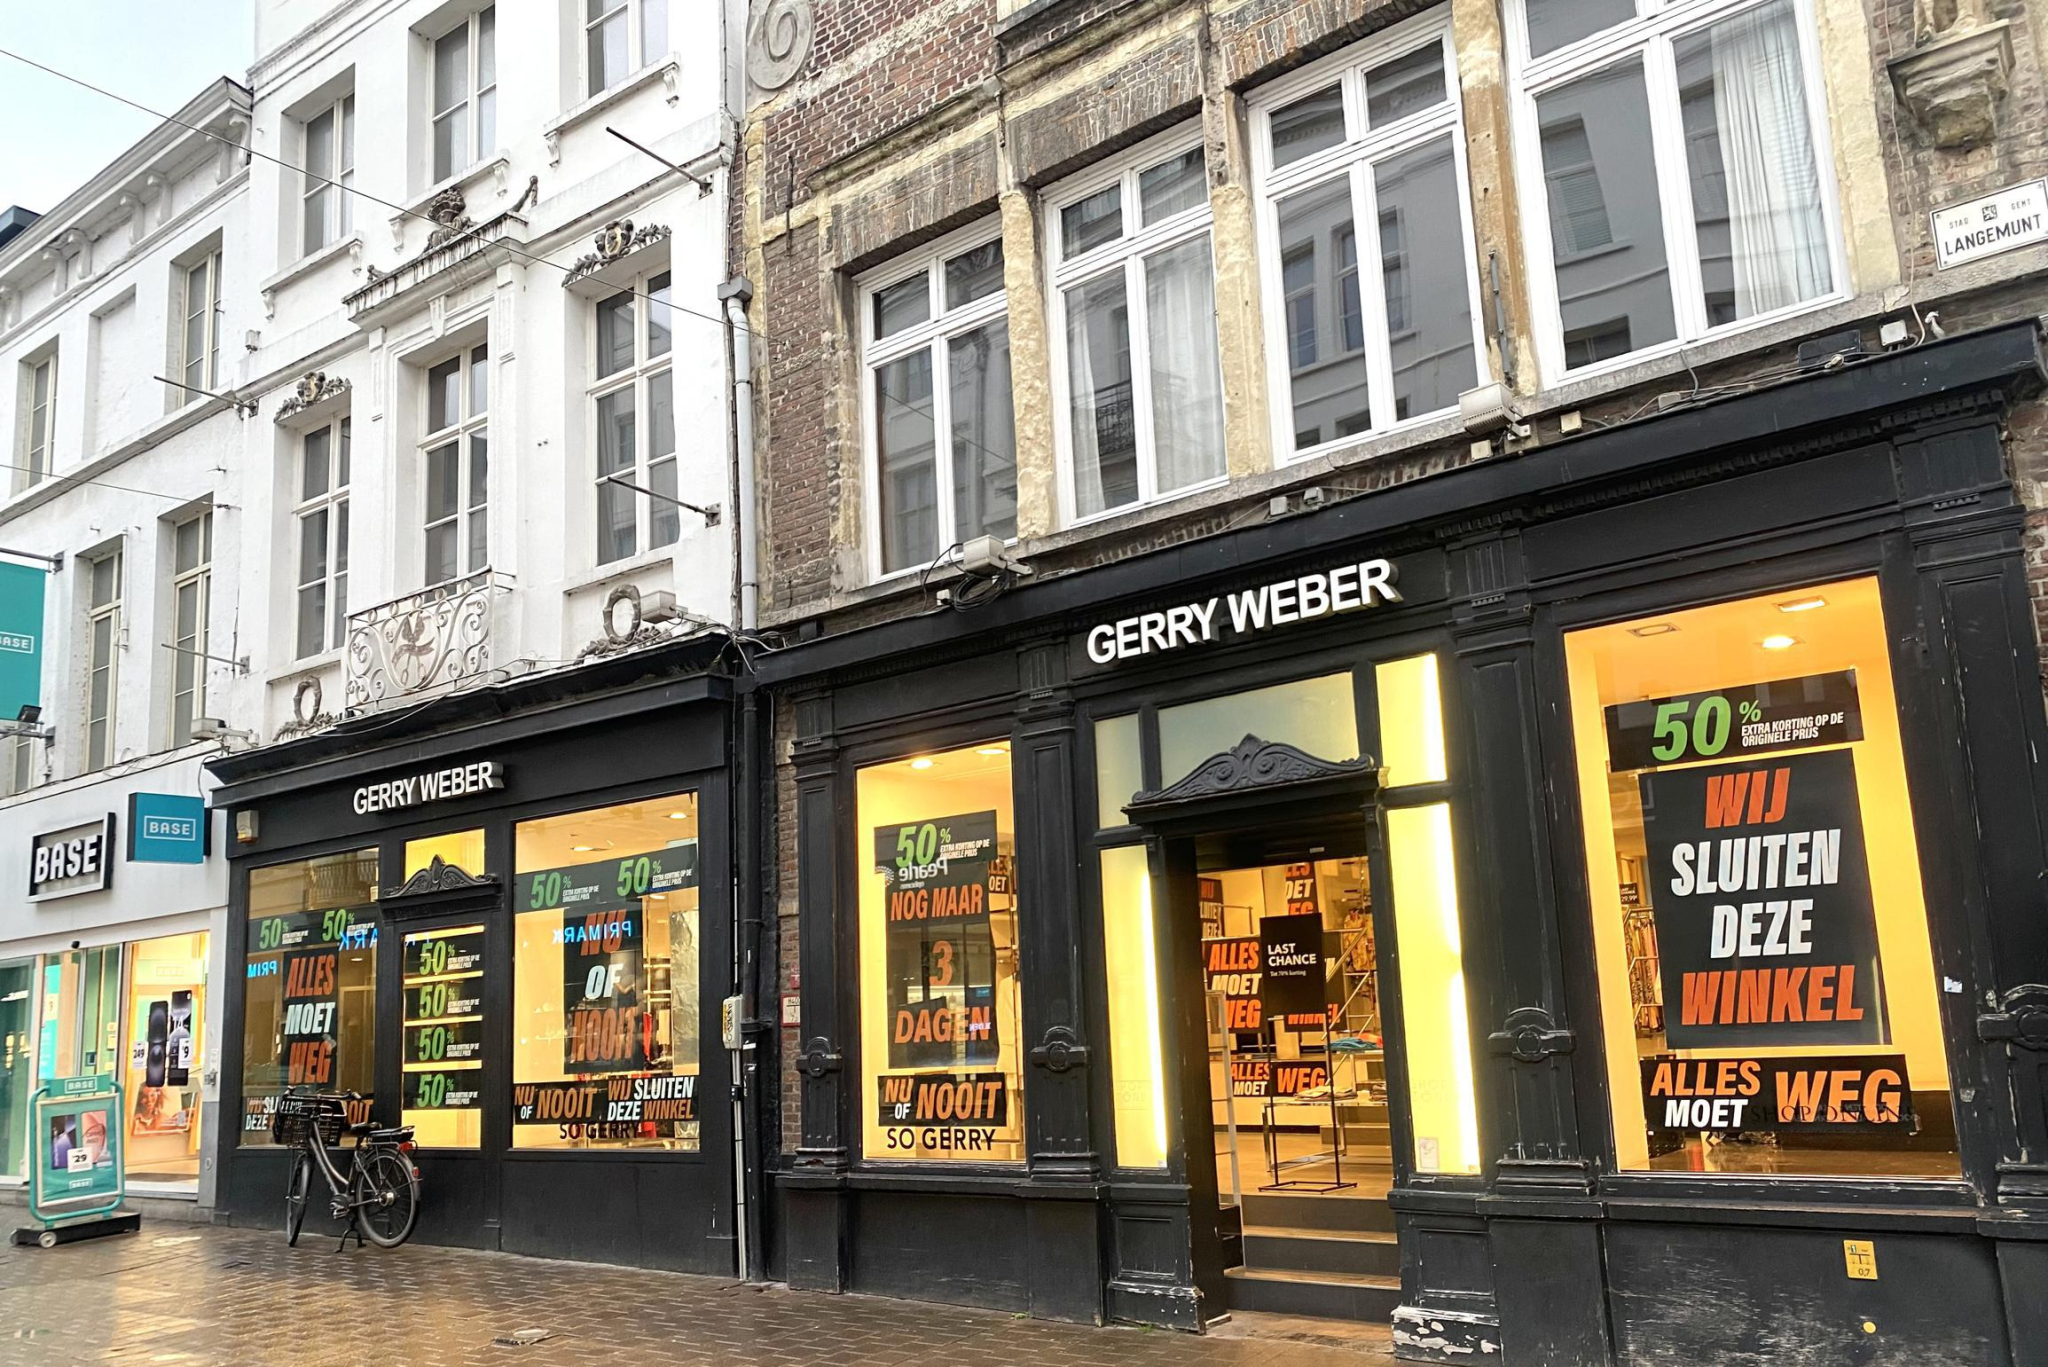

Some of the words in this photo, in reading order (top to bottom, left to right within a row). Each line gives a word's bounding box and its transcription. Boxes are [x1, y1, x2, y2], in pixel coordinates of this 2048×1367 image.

[1944, 213, 2041, 256] LANGEMUNT
[1949, 217, 1969, 229] STAD
[1087, 598, 1219, 664] GERRY
[1226, 558, 1397, 634] WEBER
[1741, 723, 1770, 737] EXTRA
[1772, 717, 1814, 731] KORTING
[1815, 714, 1830, 726] OP
[1830, 712, 1845, 725] DE
[1742, 731, 1791, 748] ORIGINELE
[1792, 727, 1819, 741] PRIJS
[353, 777, 417, 815] GERRY
[420, 761, 494, 802] WEBER
[1704, 767, 1791, 829] WIJ
[149, 821, 191, 835] BASE
[34, 835, 99, 883] BASE
[1671, 828, 1842, 897] SLUITEN
[989, 875, 1007, 892] OET
[1285, 878, 1314, 900] OET
[891, 888, 928, 921] NOG
[932, 883, 983, 917] MAAR
[580, 909, 627, 956] NU
[1710, 899, 1815, 959] DEZE
[929, 940, 953, 986] 3
[1208, 941, 1260, 971] ALLES
[1267, 943, 1296, 955] LAST
[1268, 953, 1317, 967] CHANCE
[285, 954, 335, 997] ALLES
[585, 963, 625, 1000] OF
[1211, 973, 1263, 996] MOET
[1681, 964, 1865, 1026] WINKEL
[284, 1002, 336, 1035] MOET
[894, 1006, 990, 1044] DAGEN
[570, 1006, 638, 1062] NOOIT
[288, 1041, 332, 1085] WEG
[1231, 1063, 1270, 1080] ALLES
[67, 1080, 94, 1090] BASE
[607, 1079, 632, 1100] WIJ
[633, 1076, 695, 1100] SLUITEN
[884, 1078, 914, 1102] NU
[1233, 1081, 1268, 1096] MOET
[1277, 1067, 1326, 1093] WEG
[1650, 1060, 1762, 1097] ALLES
[514, 1085, 535, 1106] NU
[536, 1088, 598, 1120] NOOIT
[606, 1101, 641, 1122] DEZE
[643, 1099, 694, 1120] WINKEL
[916, 1081, 1002, 1120] NOOIT
[1775, 1069, 1902, 1124] WEG
[245, 1114, 269, 1131] DEZE
[520, 1105, 533, 1120] OF
[895, 1103, 912, 1120] OF
[1664, 1098, 1749, 1128] MOET
[559, 1121, 581, 1140] SO
[585, 1120, 641, 1139] GERRY
[886, 1127, 916, 1150] SO
[922, 1127, 996, 1151] GERRY
